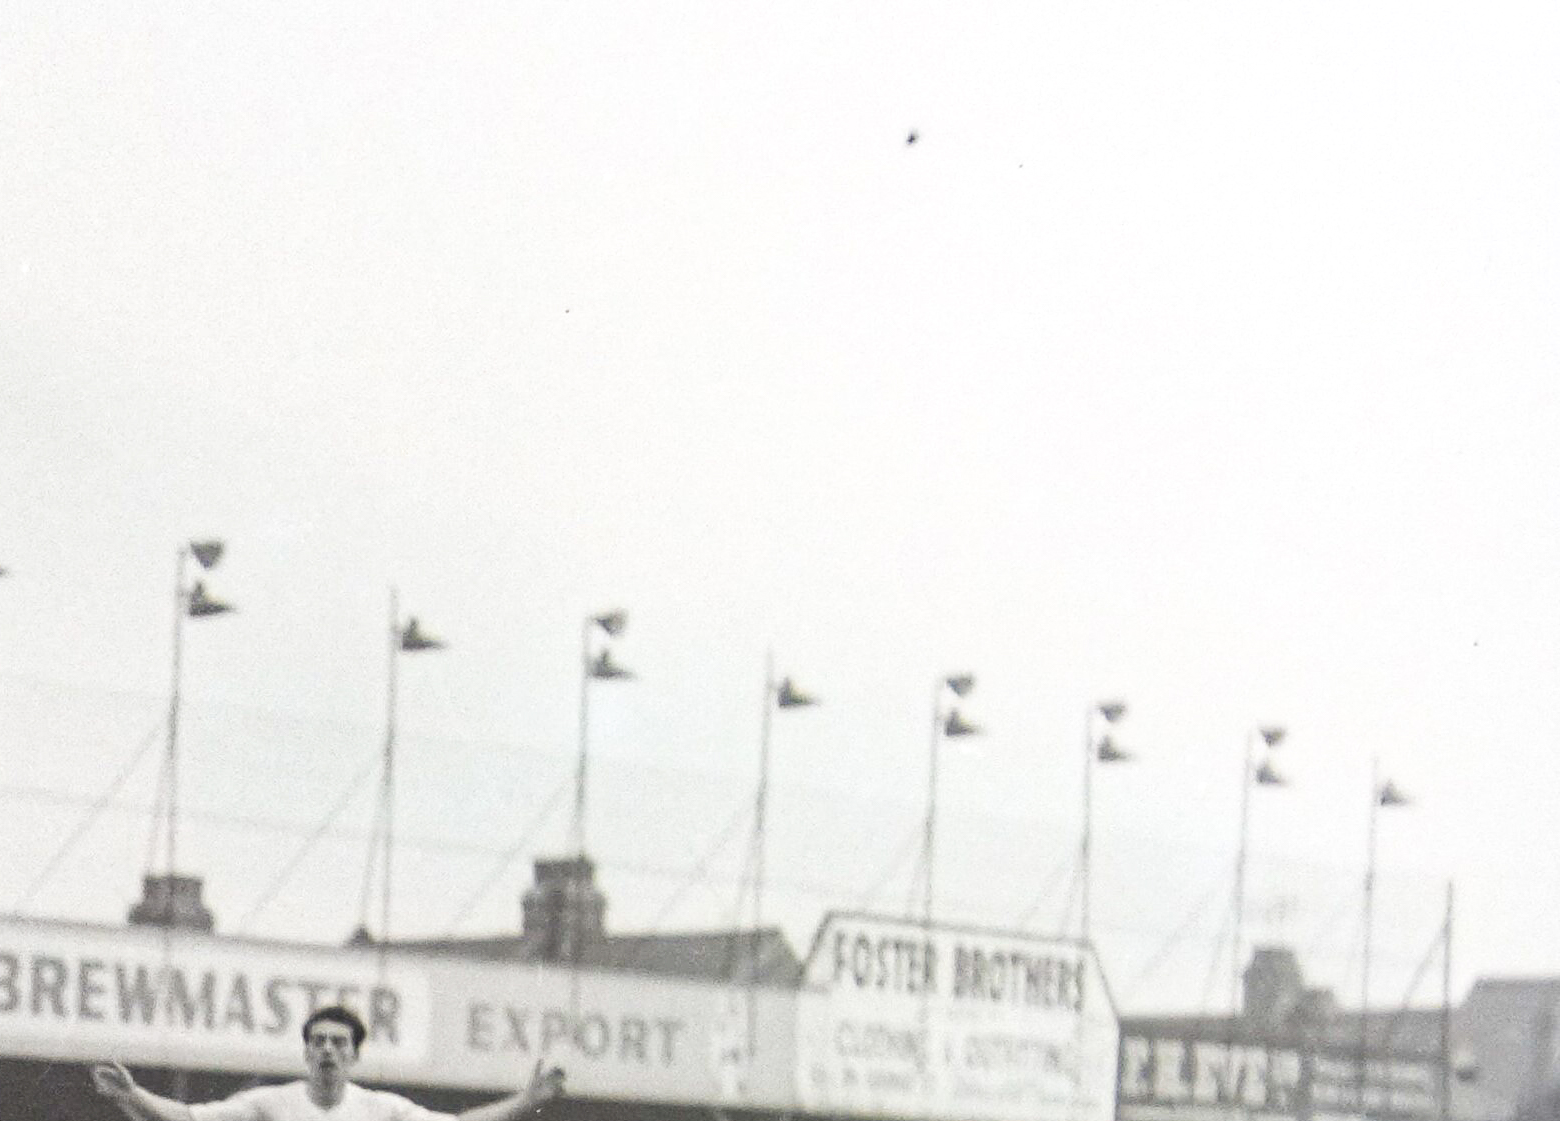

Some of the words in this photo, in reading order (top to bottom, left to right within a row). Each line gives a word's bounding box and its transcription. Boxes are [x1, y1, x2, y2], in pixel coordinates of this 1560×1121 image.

[834, 930, 937, 995] FOSTER
[953, 943, 1084, 1014] BROTHERS
[465, 1002, 684, 1068] EXPORT
